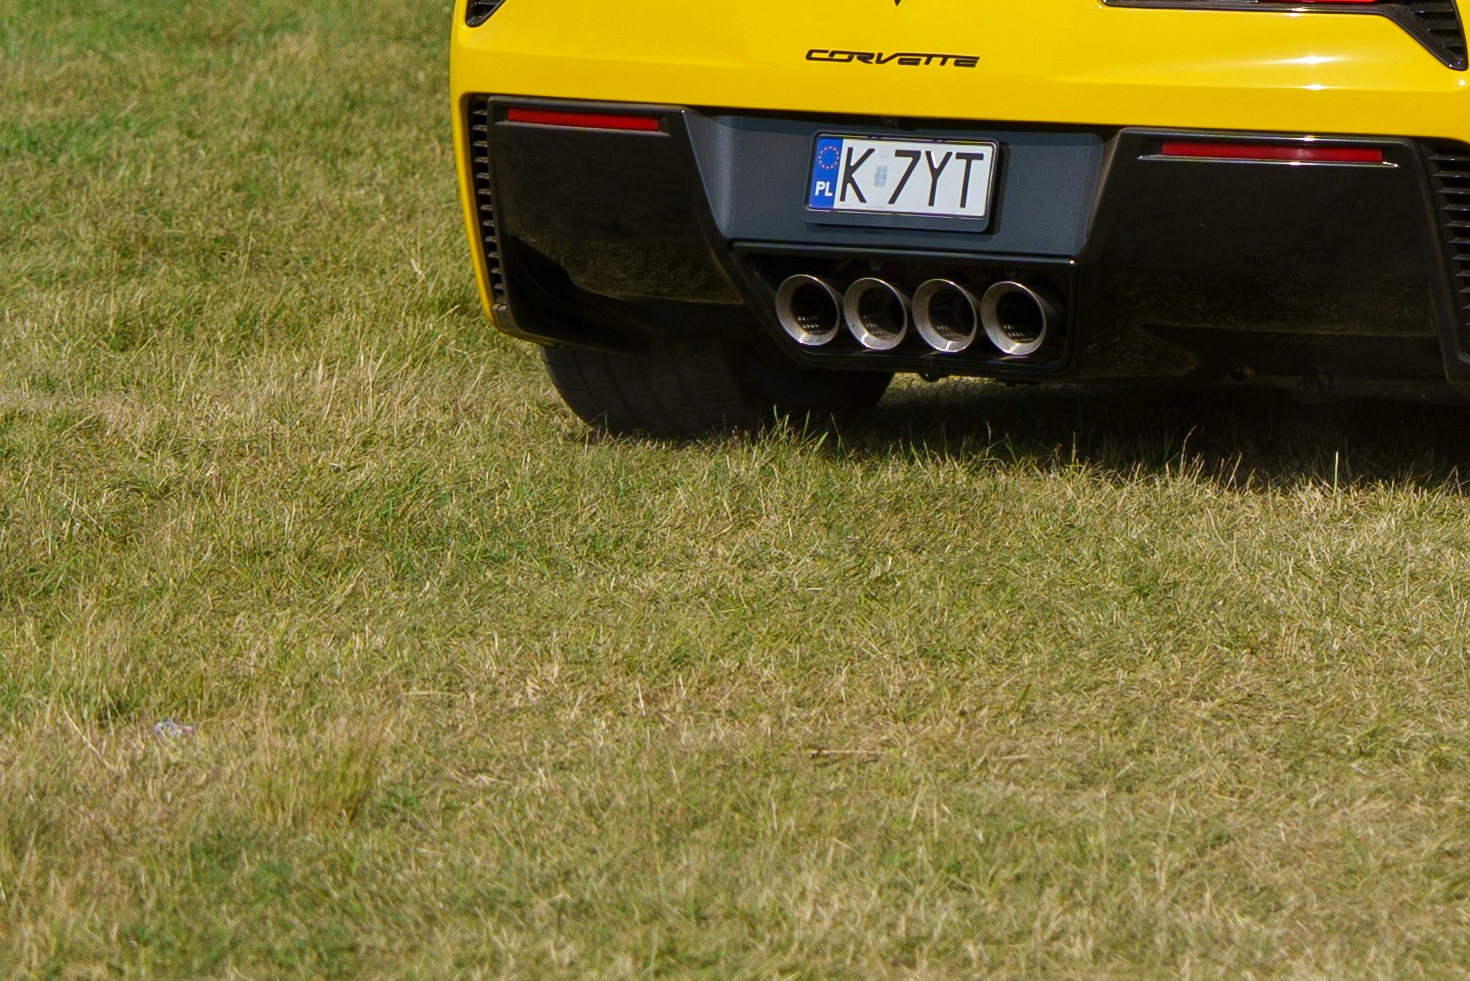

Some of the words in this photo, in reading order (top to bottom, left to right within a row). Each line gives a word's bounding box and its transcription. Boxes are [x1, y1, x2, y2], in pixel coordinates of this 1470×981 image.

[805, 49, 980, 68] CORVETTE
[839, 147, 876, 204] K
[888, 149, 985, 209] 7YT
[814, 180, 833, 197] PL
